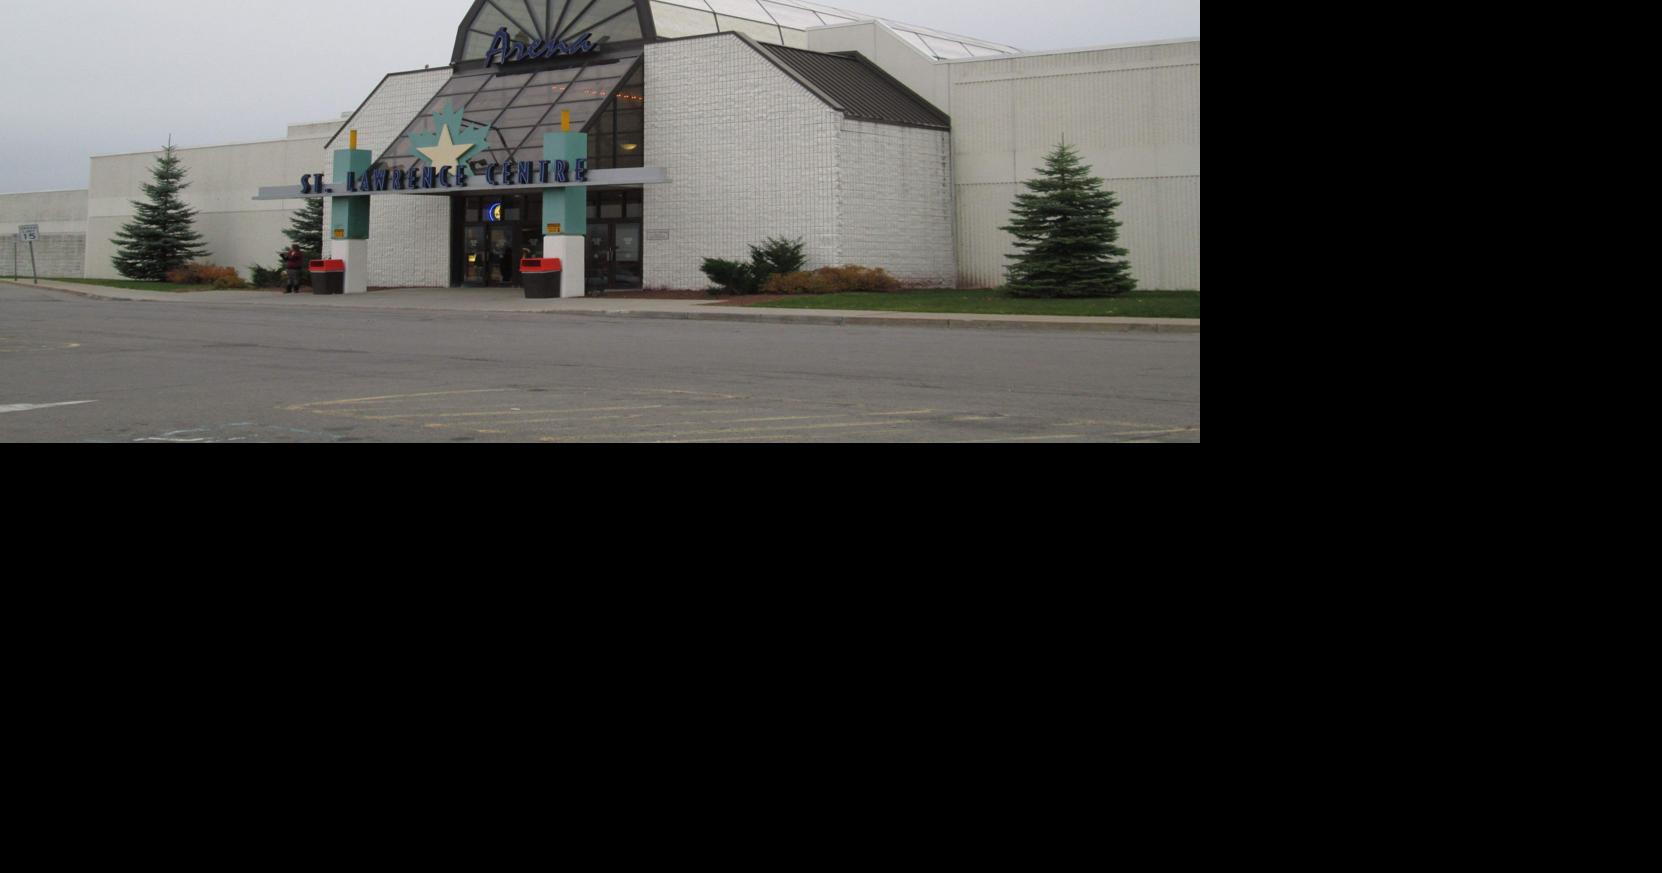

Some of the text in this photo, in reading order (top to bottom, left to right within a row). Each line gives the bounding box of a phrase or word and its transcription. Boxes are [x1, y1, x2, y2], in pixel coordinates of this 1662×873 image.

[485, 26, 595, 68] Arena
[301, 158, 587, 194] ST. LAWRENCE CENTRE
